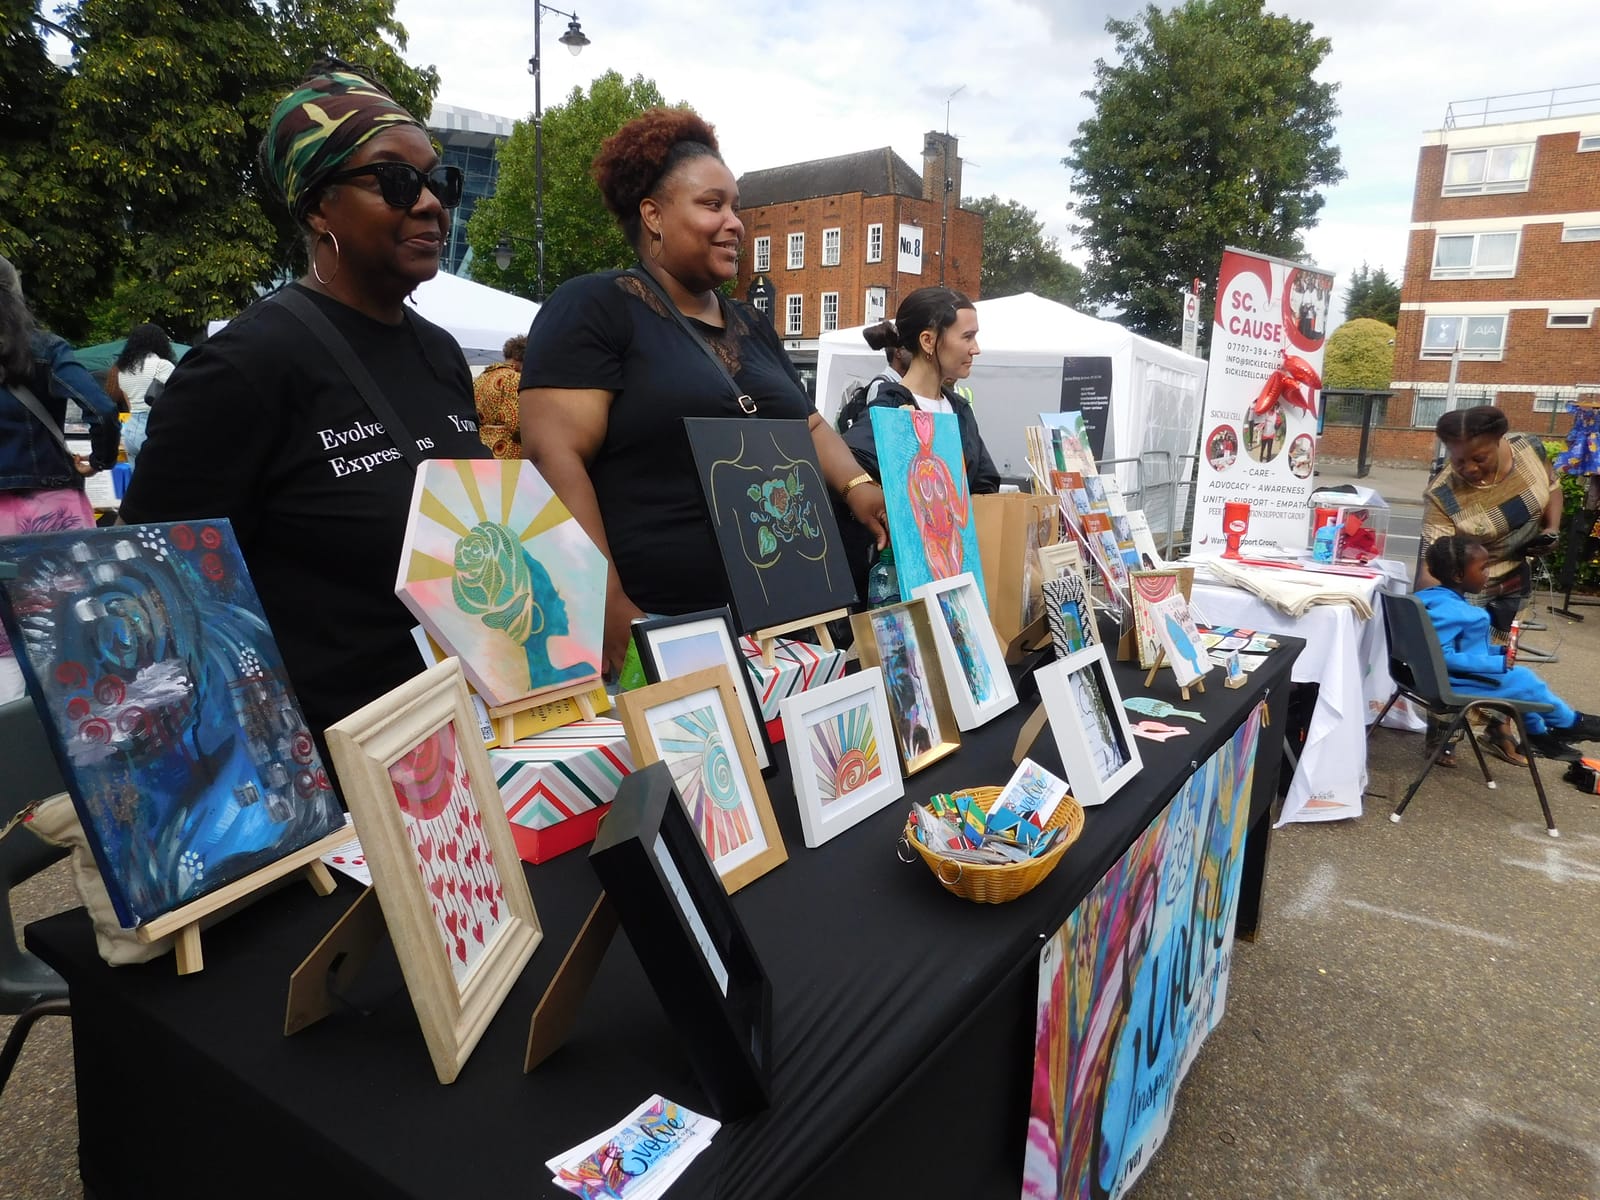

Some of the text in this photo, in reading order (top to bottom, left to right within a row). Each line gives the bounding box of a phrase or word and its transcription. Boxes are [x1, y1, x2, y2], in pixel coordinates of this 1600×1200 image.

[900, 236, 921, 257] No. 8
[1231, 289, 1257, 314] SC.
[1229, 316, 1283, 343] CAUSE
[1472, 324, 1498, 336] AIA
[1225, 368, 1271, 381] SICKLECELLCAU
[317, 421, 386, 451] Evolve
[1248, 468, 1270, 478] CARE
[1209, 480, 1306, 495] ADVOCACY AWARENESS
[1202, 495, 1227, 504] UNITY
[1276, 499, 1309, 510] EMPATH
[604, 1116, 686, 1177] Evolve
